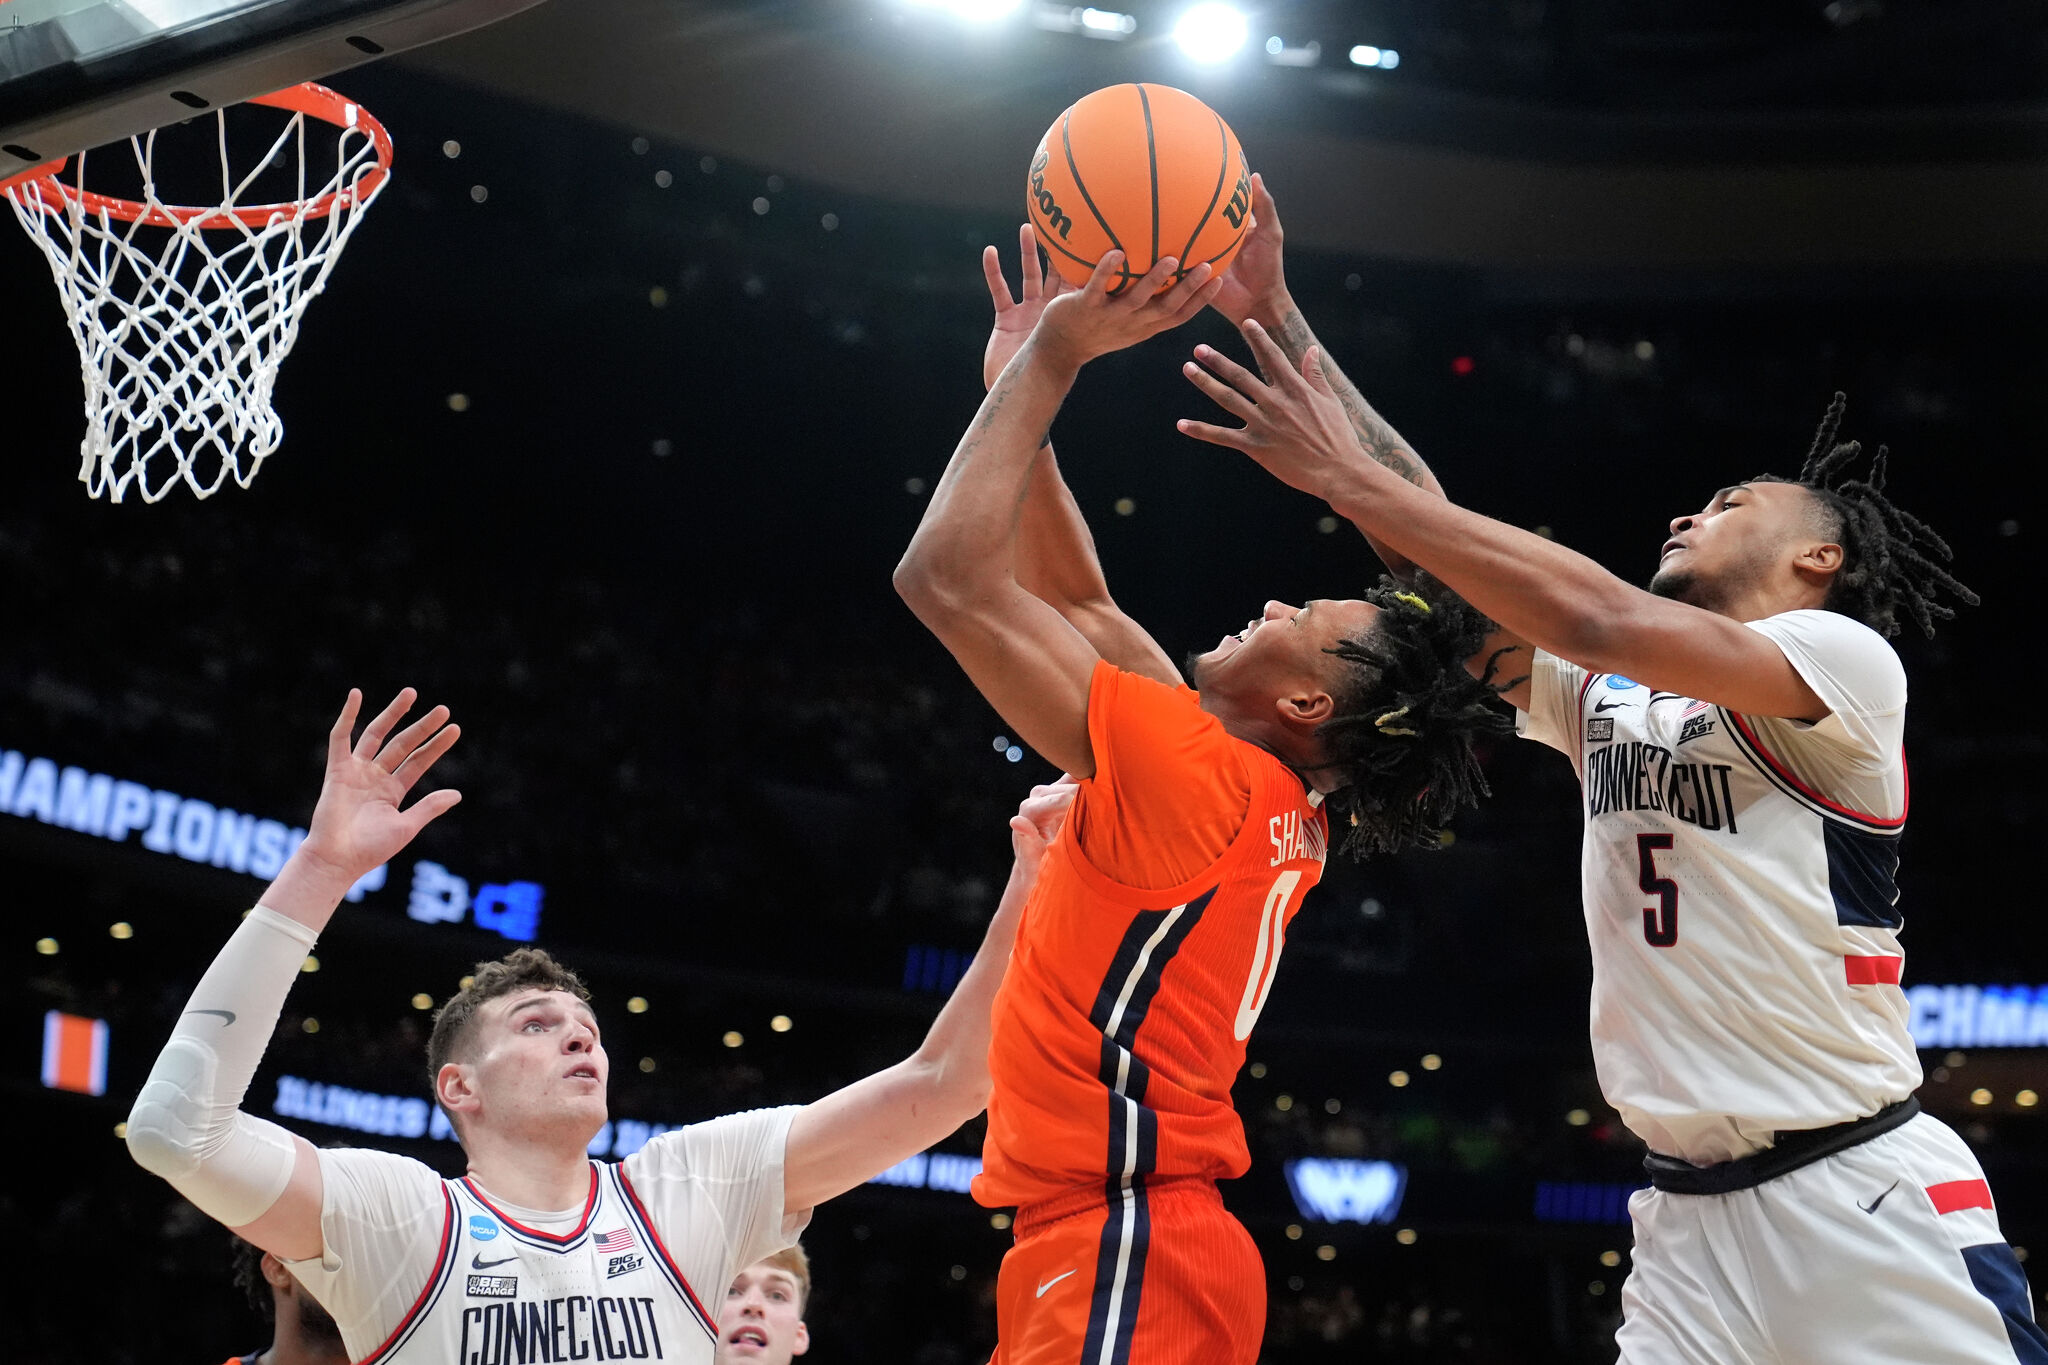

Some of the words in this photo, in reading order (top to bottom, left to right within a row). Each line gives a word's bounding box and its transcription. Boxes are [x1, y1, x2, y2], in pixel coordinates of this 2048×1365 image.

[1679, 721, 1716, 740] EAST
[1682, 714, 1706, 730] BIG
[1588, 741, 1738, 834] CONNECTICUT
[1637, 833, 1679, 947] 5
[1234, 870, 1302, 1041] 0
[470, 1224, 496, 1236] NCAA
[607, 1256, 645, 1275] EAST
[609, 1254, 634, 1267] BIG
[468, 1286, 516, 1297] CHANGE
[460, 1295, 664, 1365] CONNECICUT
